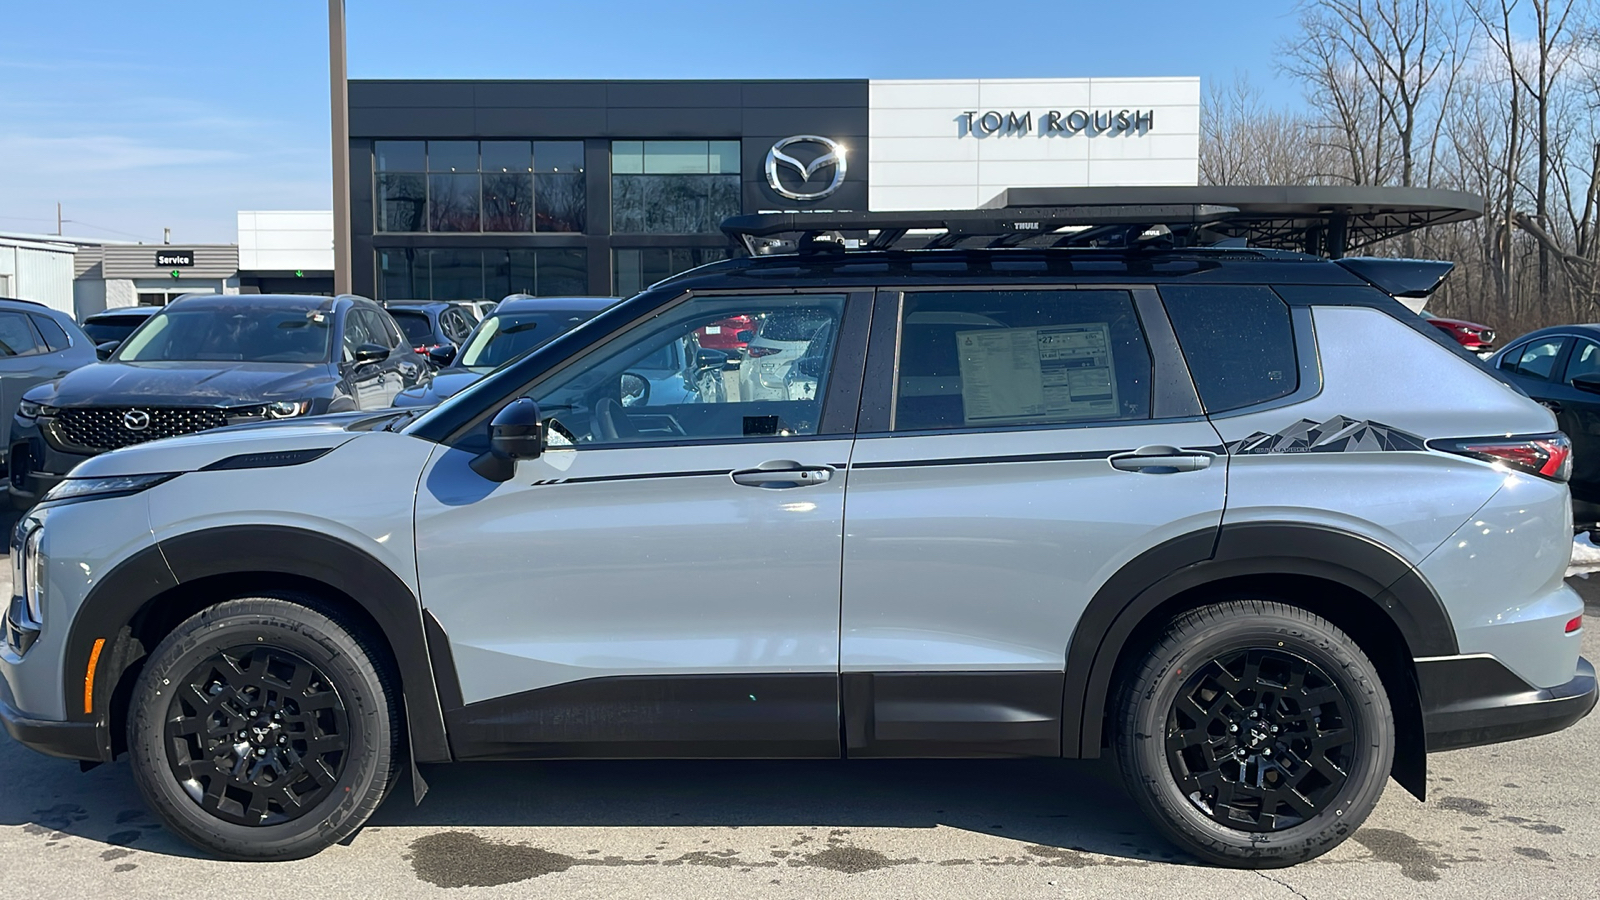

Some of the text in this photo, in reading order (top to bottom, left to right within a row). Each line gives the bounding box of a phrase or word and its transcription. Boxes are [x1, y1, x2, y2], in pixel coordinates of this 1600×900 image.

[963, 109, 1154, 132] TOM ROUSH
[1014, 222, 1039, 230] THULE
[158, 255, 189, 264] Service
